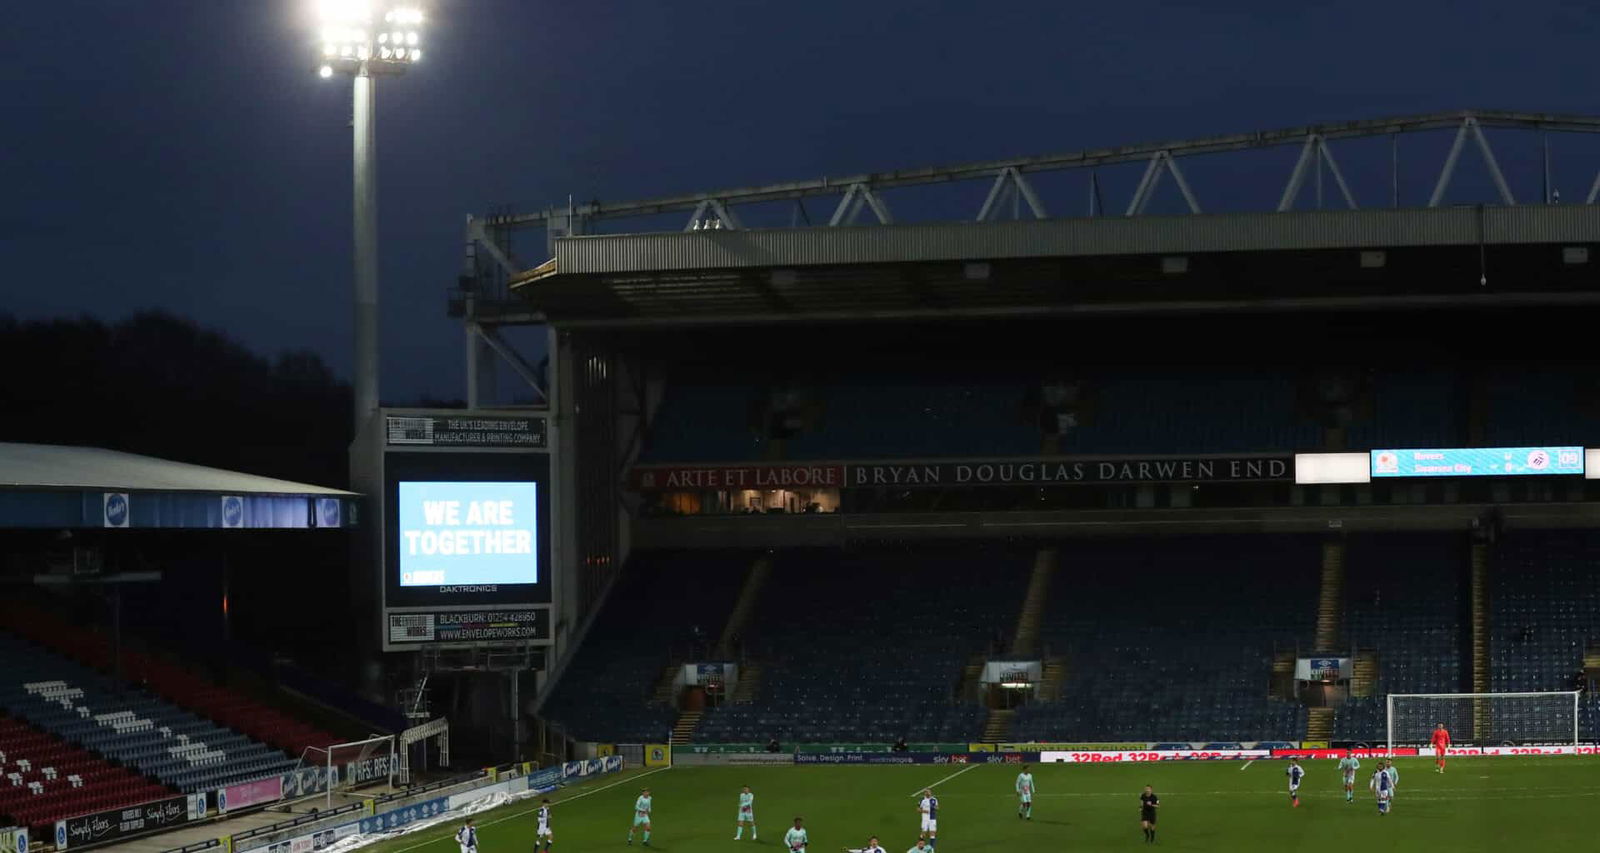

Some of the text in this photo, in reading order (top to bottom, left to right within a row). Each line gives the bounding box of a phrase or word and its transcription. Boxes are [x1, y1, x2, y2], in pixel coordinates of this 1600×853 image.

[448, 420, 459, 430] THE
[474, 420, 499, 430] LEADING
[500, 419, 528, 430] ENVELOPE
[434, 432, 480, 443] MANUFACTURER
[486, 433, 513, 443] PRINTING
[513, 432, 540, 443] COMPANY
[666, 466, 835, 487] ARTE ET LABORE
[856, 459, 1286, 485] BRYAN DOUGLAS DARWEN END
[423, 500, 514, 525] WE ARE
[405, 529, 531, 555] TOGETHER
[439, 585, 498, 593] DAKTRONICS
[440, 613, 486, 625] BLACKBURN:
[440, 627, 536, 640] WWW.ENVELOPEWORKS.COM
[933, 754, 949, 764] sky
[987, 753, 1022, 764] sky bet
[1071, 752, 1123, 763] 32Red
[70, 816, 109, 840] Simply Floors
